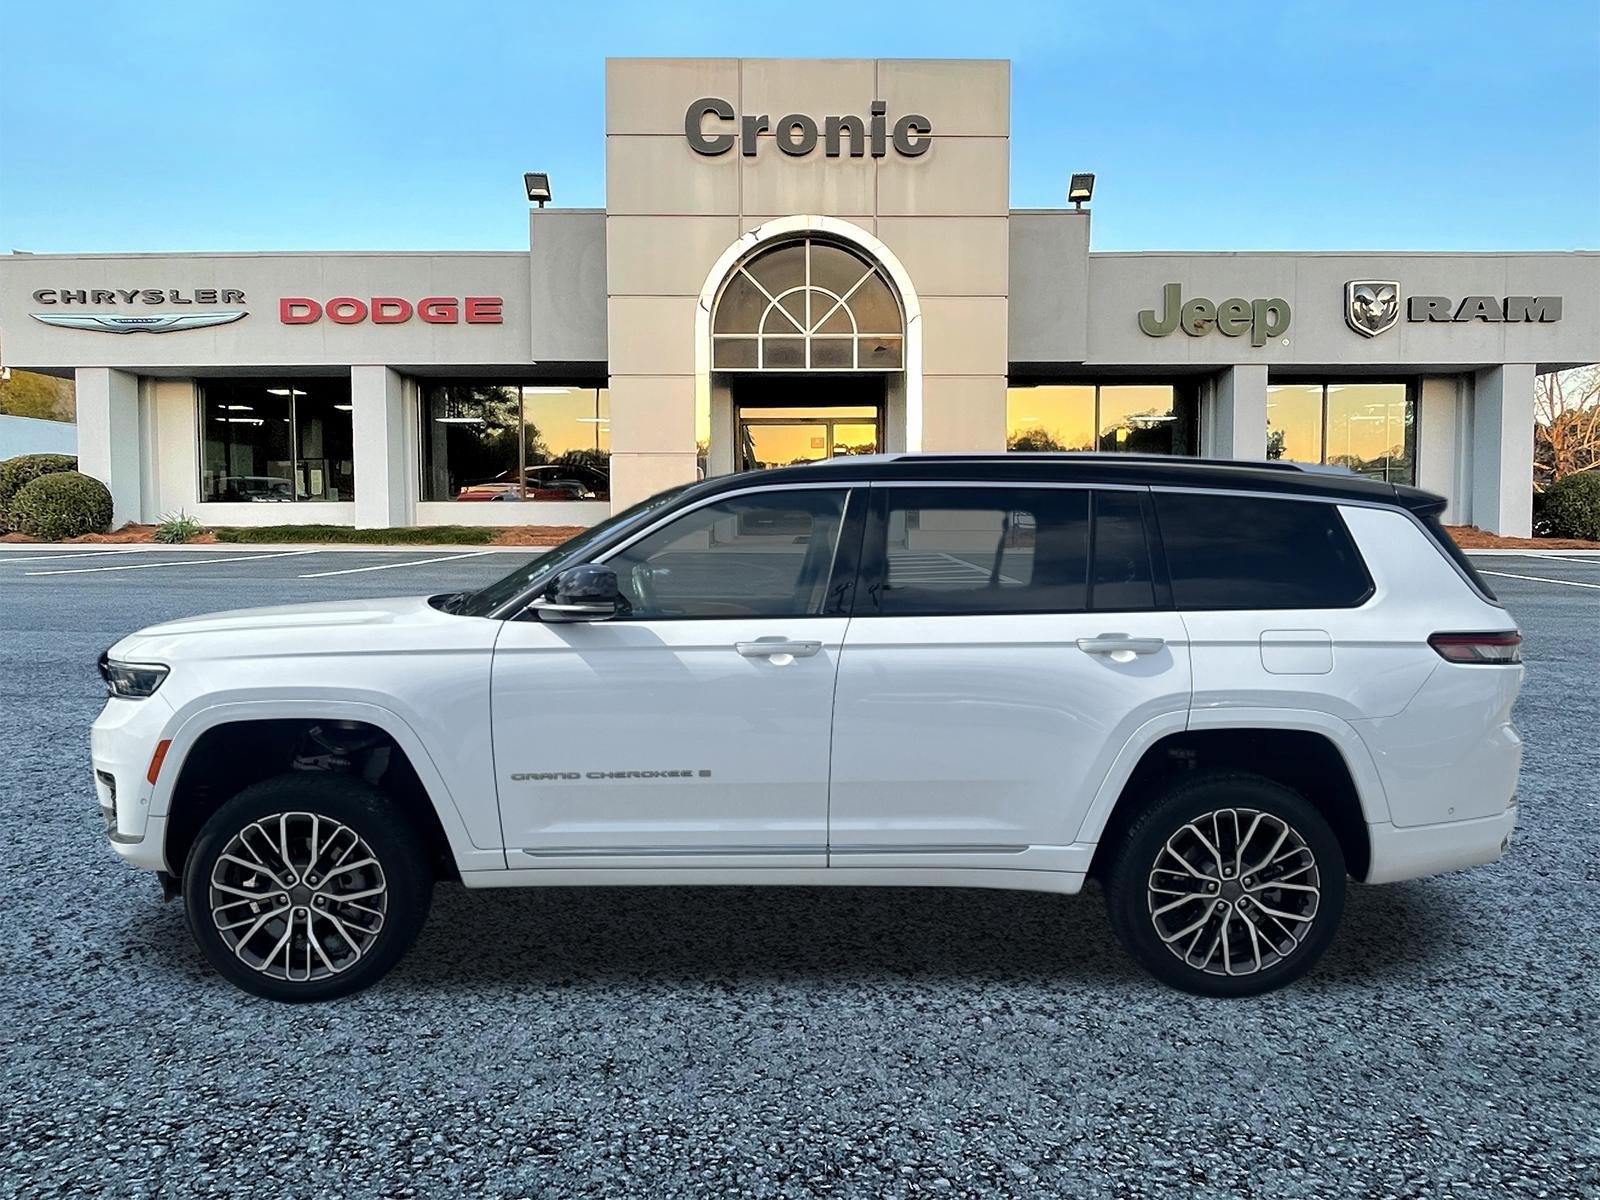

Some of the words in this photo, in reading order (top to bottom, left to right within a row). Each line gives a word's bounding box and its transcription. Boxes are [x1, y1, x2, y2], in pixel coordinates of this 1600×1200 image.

[685, 98, 932, 157] Cronic
[32, 289, 246, 304] CHRYSLER
[1407, 296, 1562, 322] RAM
[280, 297, 503, 325] DODGE
[1138, 283, 1291, 347] Jeep
[510, 772, 581, 781] GRAND
[586, 769, 693, 779] CHEROKEE
